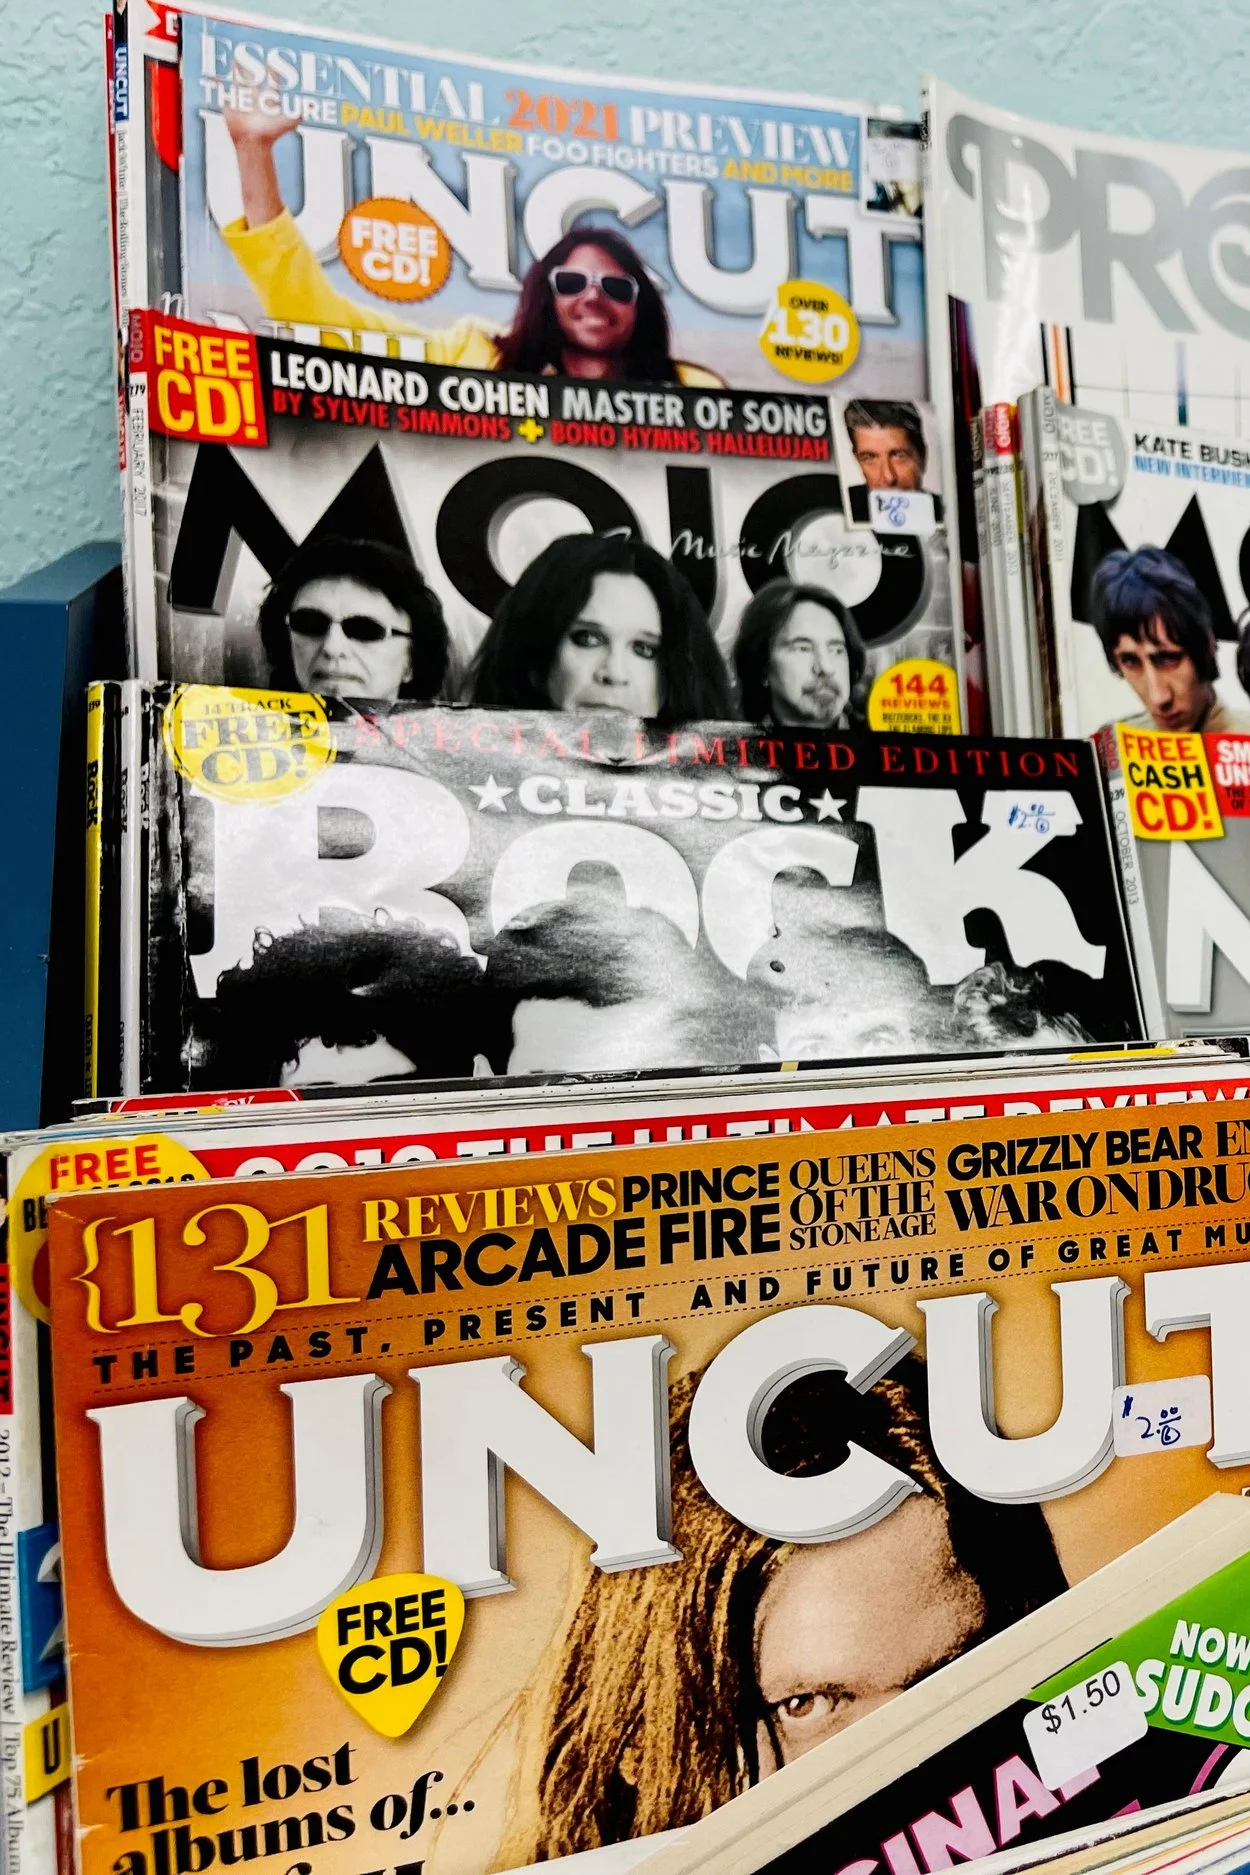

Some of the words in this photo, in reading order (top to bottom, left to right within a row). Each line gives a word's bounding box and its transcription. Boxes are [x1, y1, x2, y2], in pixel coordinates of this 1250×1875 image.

[114, 46, 129, 119] UNCUT
[199, 32, 500, 126] ESSENTIAL
[505, 87, 620, 142] 2021
[629, 104, 856, 169] PREVIEW
[200, 78, 253, 114] THE
[258, 89, 339, 125] CURE
[341, 102, 410, 138] PAUL
[415, 116, 523, 156] WELLER
[527, 135, 589, 167] FOO
[596, 144, 720, 180] FIGHTERS
[722, 159, 778, 187] AND
[781, 166, 854, 193] MORE
[198, 109, 924, 328] UNCUT
[351, 216, 439, 261] FREE
[360, 250, 432, 300] CD!
[789, 296, 830, 312] OVER
[129, 315, 144, 364] MOJO
[154, 324, 254, 380] FREE
[768, 308, 851, 351] 130
[157, 369, 259, 440] CD!
[270, 350, 432, 409] LEONARD
[439, 376, 550, 420] COHEN
[562, 385, 685, 428] MASTER
[693, 399, 736, 432] OF
[742, 401, 828, 438] SONG
[131, 407, 146, 479] FEBRUARY
[272, 390, 304, 416] BY
[312, 397, 391, 430] SYLVIE
[395, 402, 512, 441] SIMMONS
[550, 422, 616, 449] BONO
[622, 428, 701, 454] HYMNS
[706, 432, 831, 463] HALLELUJAH
[1134, 433, 1192, 461] KATE
[1134, 455, 1173, 477] NEW
[134, 487, 147, 518] 2017
[169, 441, 926, 649] MOJO
[223, 698, 293, 714] TRACK
[890, 672, 949, 698] 144
[182, 710, 320, 750] FREE
[354, 713, 600, 760] SPECIAL
[634, 729, 858, 773] LIMITED
[881, 740, 1081, 778] EDITION
[1121, 731, 1199, 762] FREE
[201, 744, 307, 785] CD!
[1128, 761, 1205, 790] CASH
[518, 775, 809, 824] CLASSIC
[1135, 792, 1215, 833] CD!
[1225, 786, 1248, 799] THE
[1231, 799, 1247, 811] OF
[1115, 811, 1134, 871] OCTOBER
[1124, 876, 1139, 906] 2013
[50, 1144, 162, 1190] FREE
[362, 1177, 618, 1243] REVIEWS
[622, 1160, 780, 1214] PRINCE
[789, 1147, 937, 1197] QUEENS
[947, 1131, 1100, 1181] GRIZZLY
[1106, 1124, 1203, 1167] BEAR
[366, 1218, 646, 1301] ARCADE
[658, 1203, 781, 1267] FIRE
[789, 1186, 840, 1227] OF
[841, 1178, 937, 1220] THE
[945, 1179, 1063, 1232] WAR
[1066, 1171, 1141, 1218] ON
[788, 1219, 877, 1251] STONE
[882, 1211, 937, 1240] AGE
[94, 1344, 196, 1385] THE
[230, 1324, 394, 1368] PAST,
[424, 1291, 646, 1343] PRESENT
[690, 1275, 782, 1310] AND
[806, 1253, 967, 1296] FUTURE
[988, 1243, 1038, 1274] OF
[1057, 1230, 1184, 1265] GREAT
[336, 1588, 448, 1648] FREE
[336, 1629, 450, 1696] CD!
[1041, 1668, 1123, 1737] $1.50
[3, 1733, 23, 1771] Top
[107, 1771, 230, 1834] The
[241, 1741, 360, 1811] lost
[109, 1803, 356, 1875] albums
[370, 1770, 476, 1841] of...
